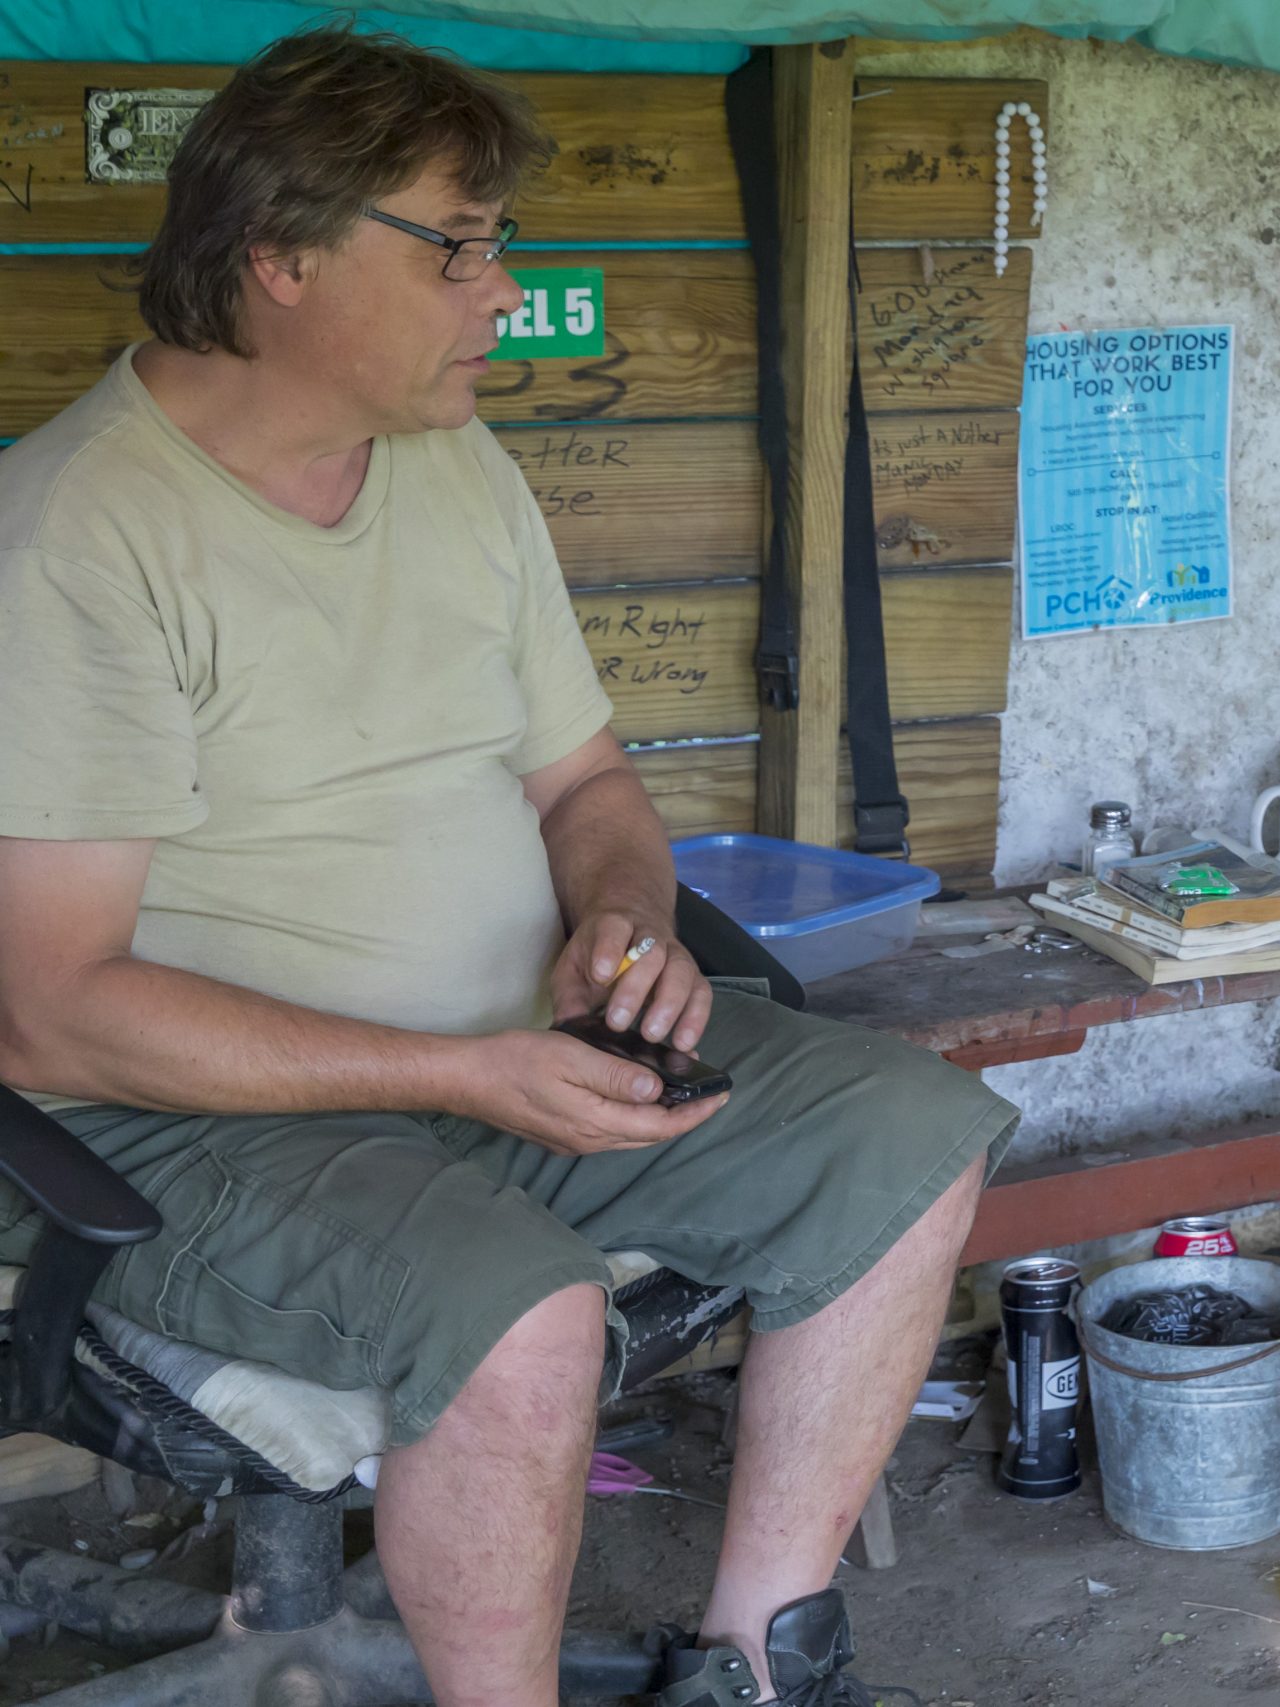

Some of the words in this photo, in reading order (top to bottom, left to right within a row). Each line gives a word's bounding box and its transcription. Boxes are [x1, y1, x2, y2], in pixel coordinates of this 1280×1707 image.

[497, 288, 556, 338] EL
[565, 287, 596, 337] 5
[1026, 336, 1119, 361] HOUSING
[1130, 332, 1229, 352] OPTIONS
[1029, 359, 1081, 382] THAT
[1091, 354, 1161, 374] WORK
[1171, 352, 1221, 372] BEST
[1073, 379, 1114, 399] FOR
[1124, 375, 1172, 394] YOU
[1093, 403, 1147, 416] SERCES
[530, 485, 602, 516] se
[1095, 506, 1125, 518] STOP
[1150, 586, 1228, 605] Providence
[598, 655, 623, 681] R
[1184, 1238, 1220, 1256] 25
